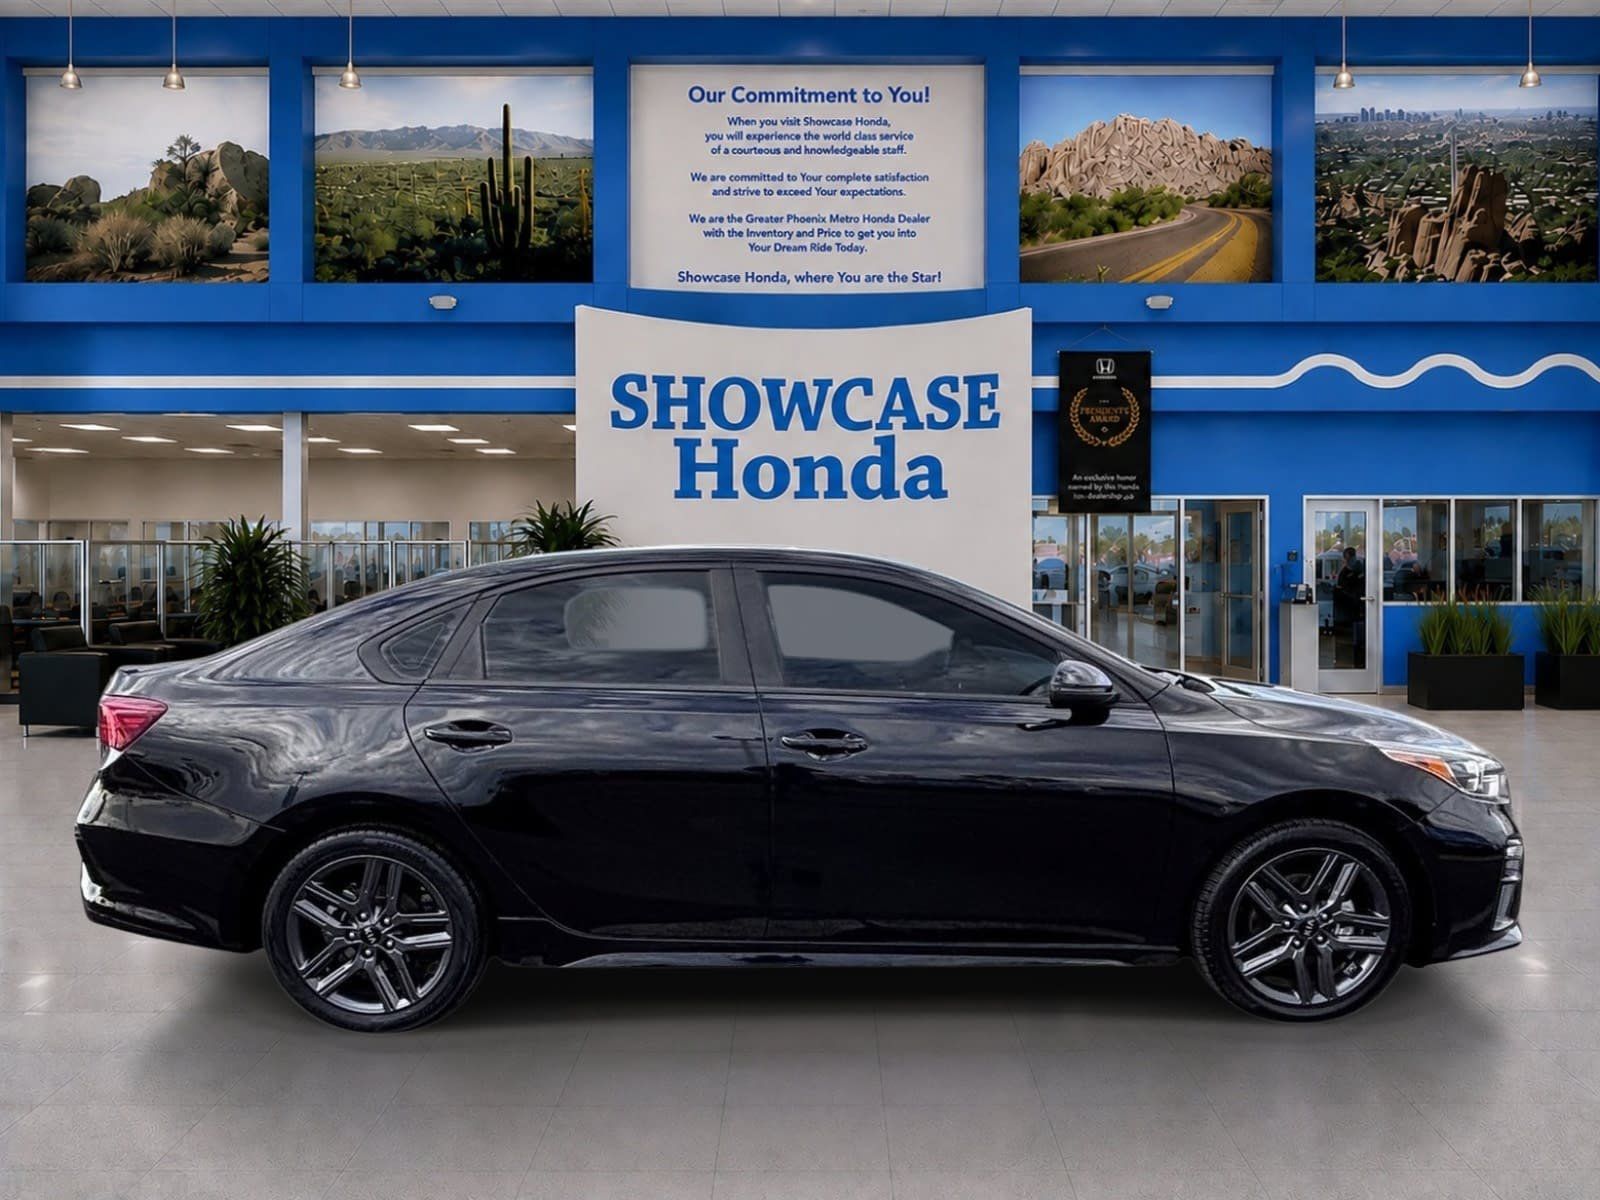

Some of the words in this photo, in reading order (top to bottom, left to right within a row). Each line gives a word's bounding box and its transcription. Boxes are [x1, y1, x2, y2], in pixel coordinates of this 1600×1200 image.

[687, 85, 727, 104] Our
[730, 85, 858, 105] Commitment
[861, 87, 884, 104] to
[887, 85, 931, 104] You!
[726, 116, 758, 128] When
[758, 118, 779, 129] you
[779, 116, 802, 127] visit
[802, 116, 854, 127] Showcase
[854, 116, 892, 129] Honda,
[704, 132, 724, 145] you
[725, 130, 744, 143] will
[745, 130, 802, 145] experience
[803, 130, 821, 143] the
[822, 130, 852, 143] world
[853, 130, 878, 143] class
[878, 130, 915, 143] service
[710, 143, 722, 155] of
[722, 147, 731, 156] a
[730, 146, 782, 156] courteous
[782, 144, 803, 156] and
[881, 143, 907, 156] staff.
[689, 171, 708, 183] We
[709, 174, 727, 183] are
[728, 171, 785, 183] committed
[786, 173, 798, 183] to
[799, 171, 823, 183] Your
[824, 171, 873, 185] complete
[873, 171, 930, 183] satisfaction
[711, 185, 732, 197] and
[732, 186, 762, 197] strive
[762, 187, 775, 197] to
[775, 186, 813, 197] exceed
[814, 186, 839, 197] Your
[839, 185, 907, 200] expectations.
[688, 213, 707, 225] We
[707, 215, 725, 225] are
[726, 212, 744, 224] the
[744, 213, 785, 225] Greater
[785, 213, 828, 224] Phoenix
[828, 213, 861, 224] Metro
[862, 213, 896, 225] Honda
[897, 212, 932, 225] Dealer
[702, 227, 726, 239] with
[726, 227, 745, 239] the
[745, 227, 795, 241] Inventory
[794, 227, 816, 239] and
[816, 227, 843, 239] Price
[843, 229, 856, 239] to
[856, 228, 876, 241] get
[876, 230, 896, 241] you
[896, 227, 918, 239] into
[747, 241, 772, 253] Your
[773, 241, 808, 253] Dream
[809, 241, 833, 253] Ride
[834, 241, 868, 256] Today.
[677, 270, 742, 284] Showcase
[744, 270, 791, 286] Honda,
[793, 270, 835, 284] where
[836, 271, 861, 284] You
[863, 274, 885, 284] are
[886, 270, 909, 284] the
[911, 270, 942, 284] Star!
[610, 373, 1001, 431] SHOWCASE
[673, 434, 949, 501] Honda
[1072, 474, 1083, 482] An
[364, 926, 376, 944] KIA
[1303, 919, 1315, 936] KIA
